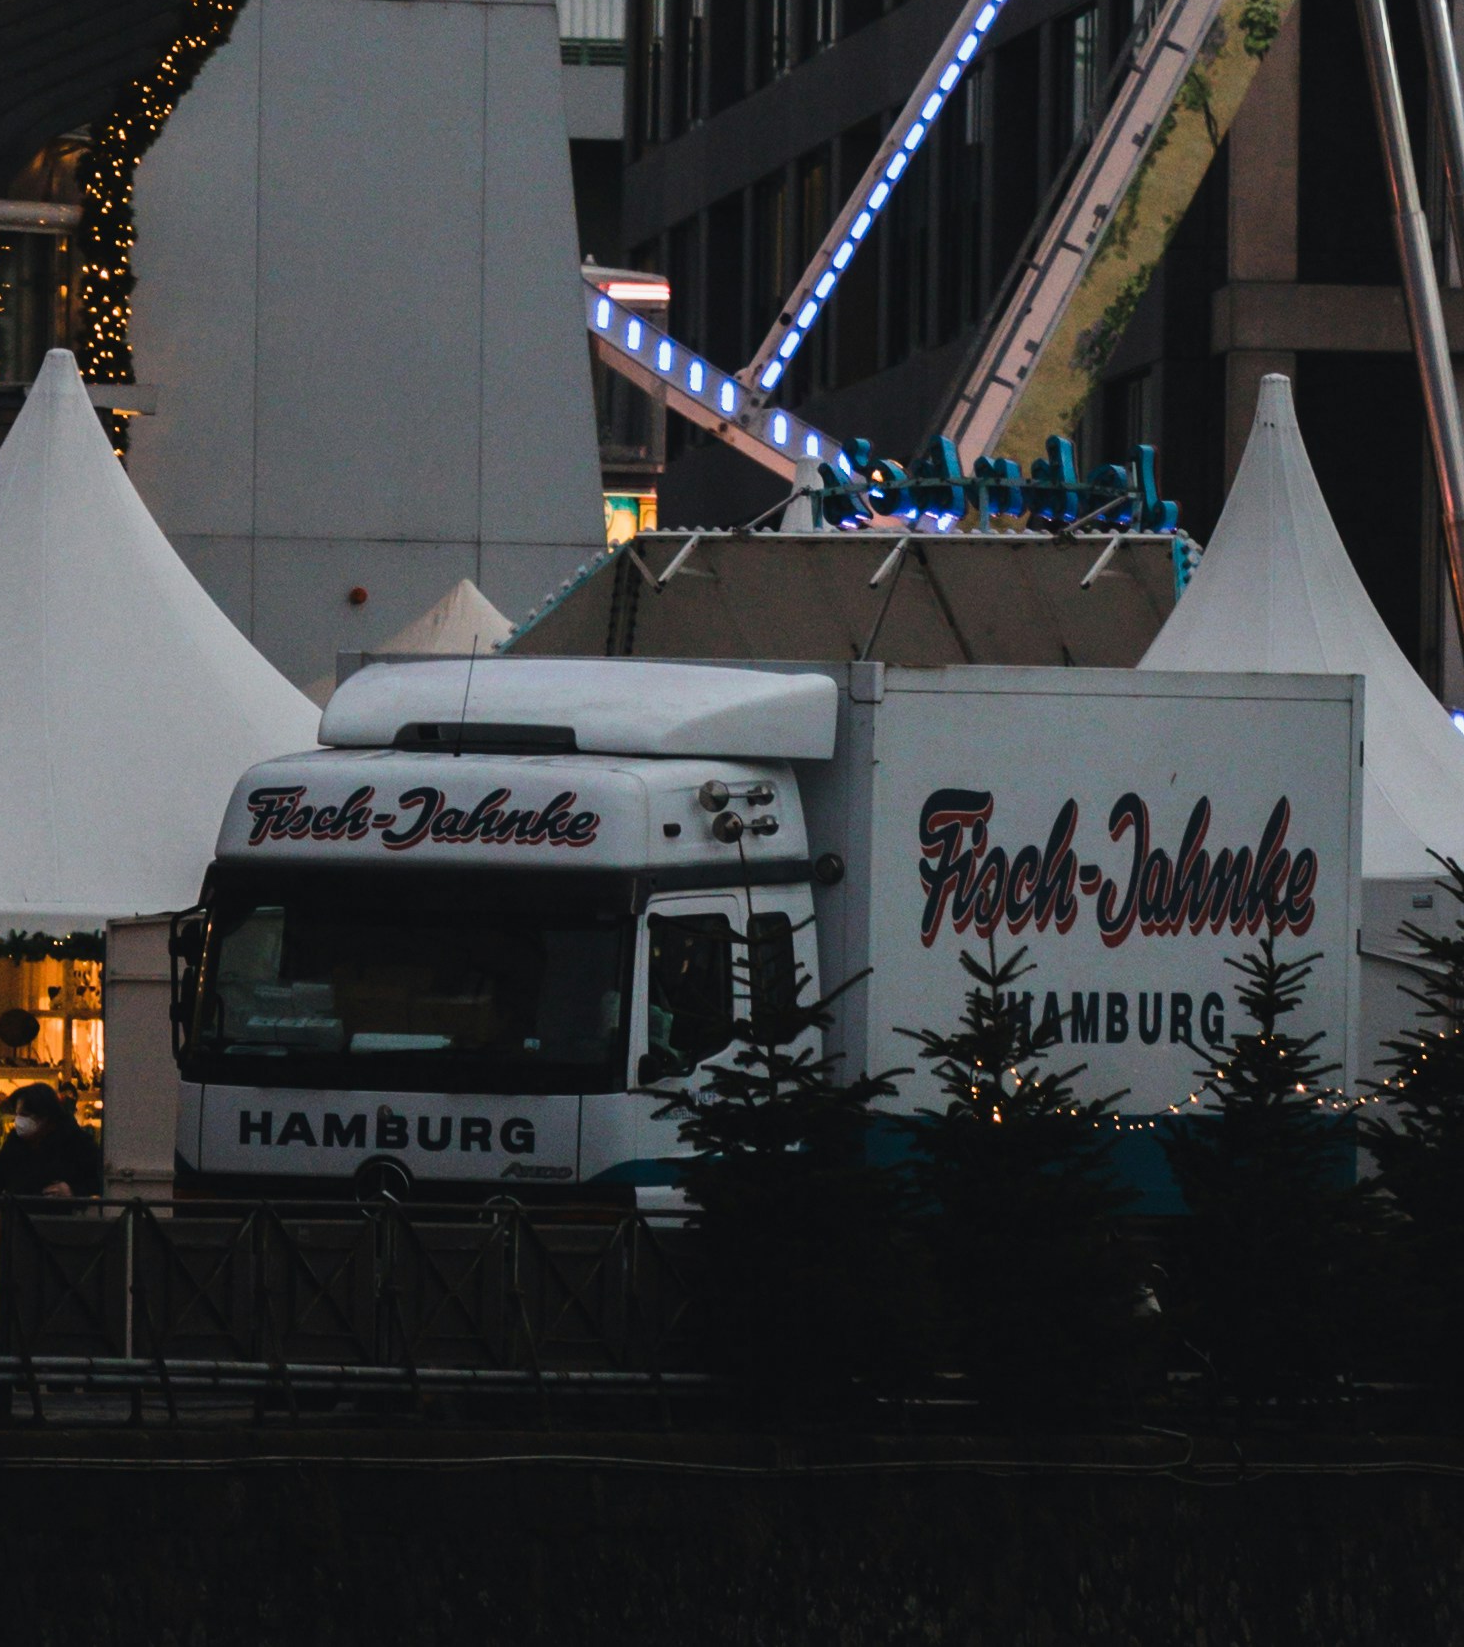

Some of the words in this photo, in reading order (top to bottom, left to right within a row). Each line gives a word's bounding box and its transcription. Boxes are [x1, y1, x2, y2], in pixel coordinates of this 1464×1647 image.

[246, 785, 601, 850] Fisch-Jahnke
[918, 788, 1318, 947] Fisch-Jahnke
[1006, 991, 1225, 1045] HAMBURG
[239, 1110, 535, 1154] HAMBURG
